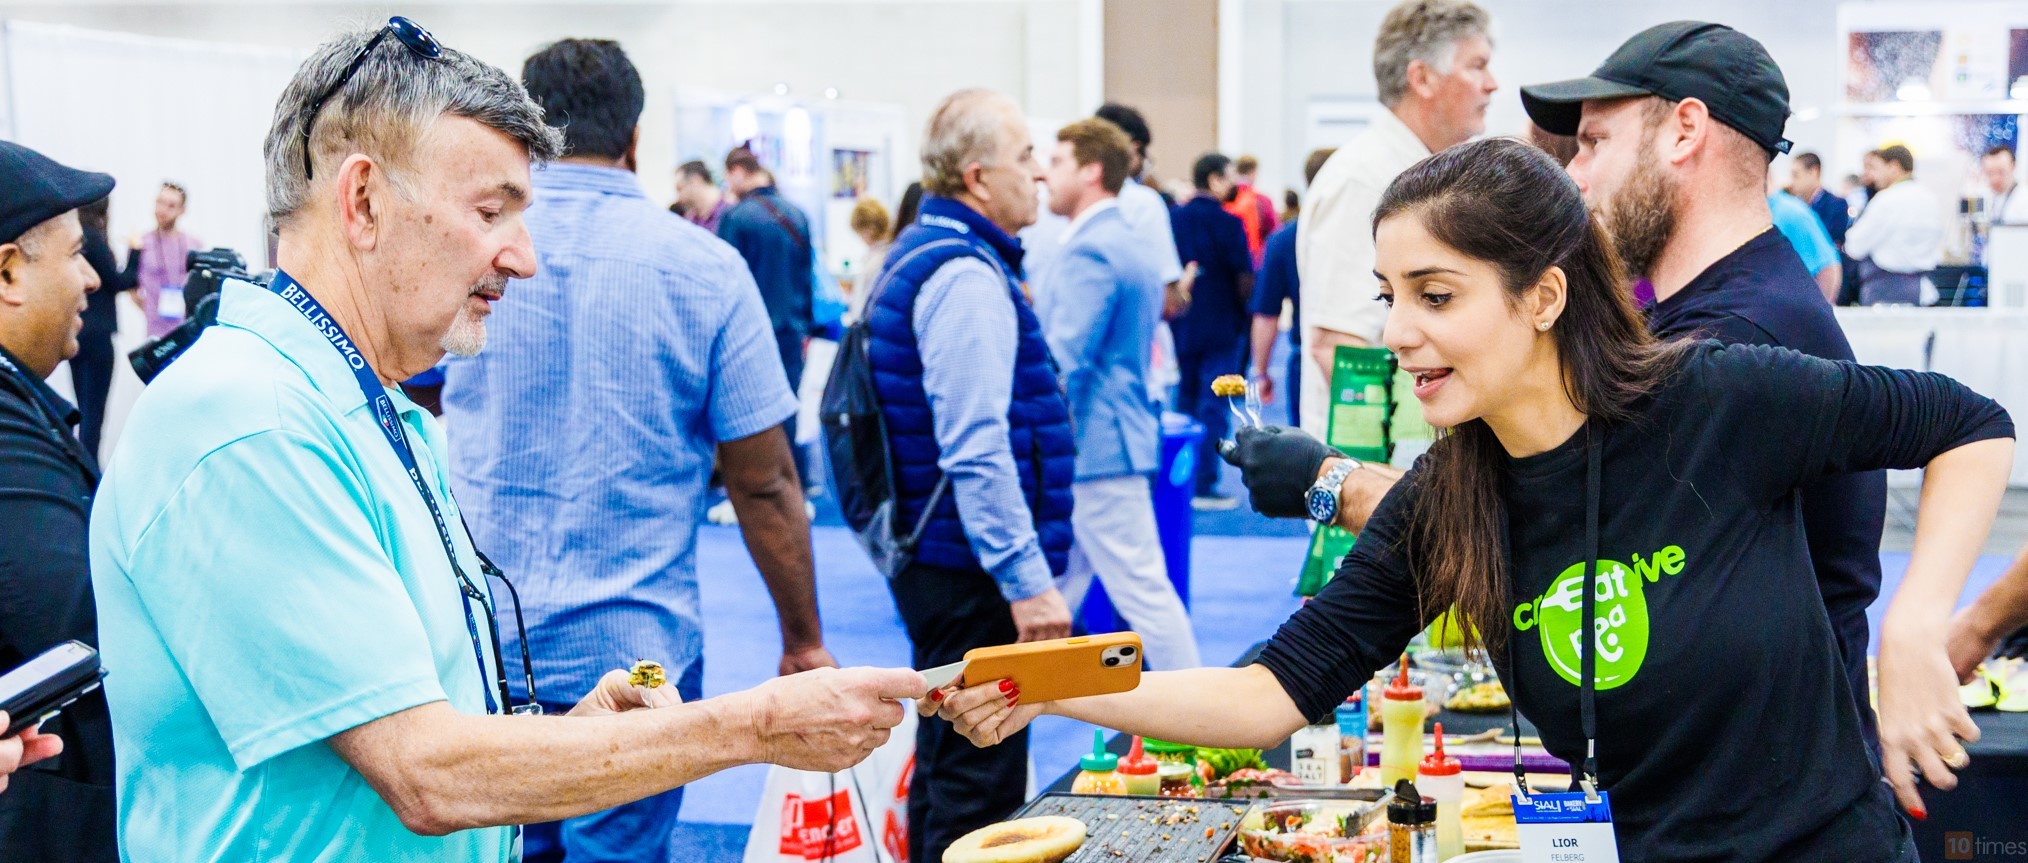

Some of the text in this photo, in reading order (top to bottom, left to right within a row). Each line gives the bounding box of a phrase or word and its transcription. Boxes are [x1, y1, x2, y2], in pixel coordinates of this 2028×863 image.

[280, 283, 365, 370] BELLISSIMO
[380, 399, 399, 438] BELLISSIMO
[1534, 800, 1558, 810] SIAL
[1552, 838, 1579, 848] LIOR
[1551, 853, 1585, 862] FELBERG
